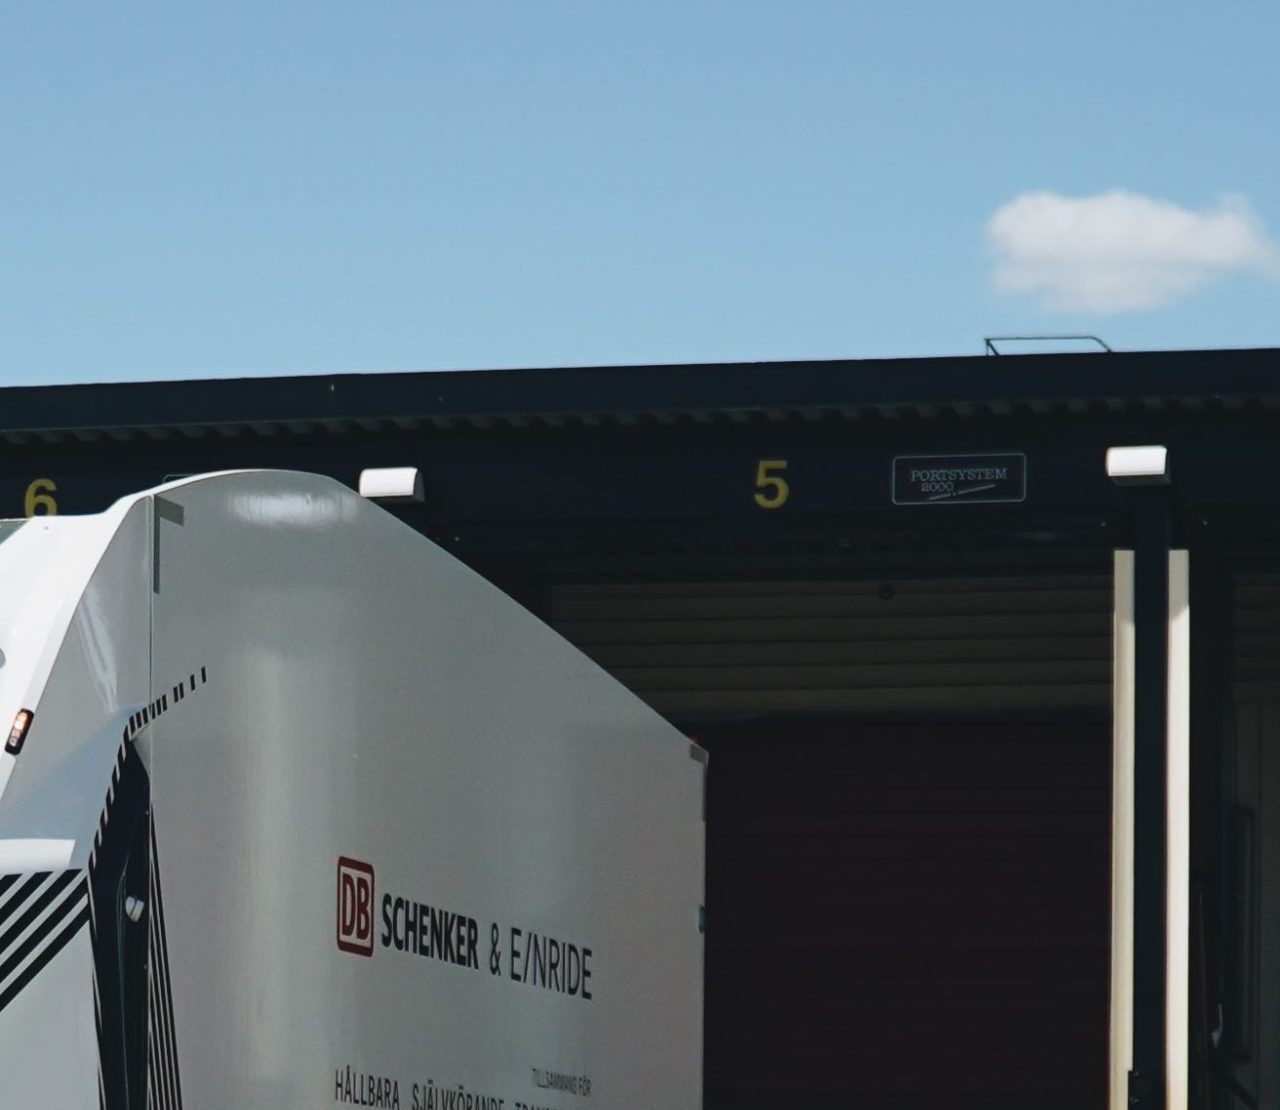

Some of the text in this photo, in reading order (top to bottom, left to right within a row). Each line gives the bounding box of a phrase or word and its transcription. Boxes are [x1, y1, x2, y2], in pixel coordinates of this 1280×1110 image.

[754, 460, 789, 508] 5
[910, 468, 1008, 481] PORTSYSTEM
[921, 482, 954, 492] 2000
[25, 478, 57, 518] 6
[340, 871, 372, 943] DB
[381, 893, 479, 969] SCHENKER
[489, 922, 501, 976] &
[335, 1065, 400, 1110] HÅLLBARA
